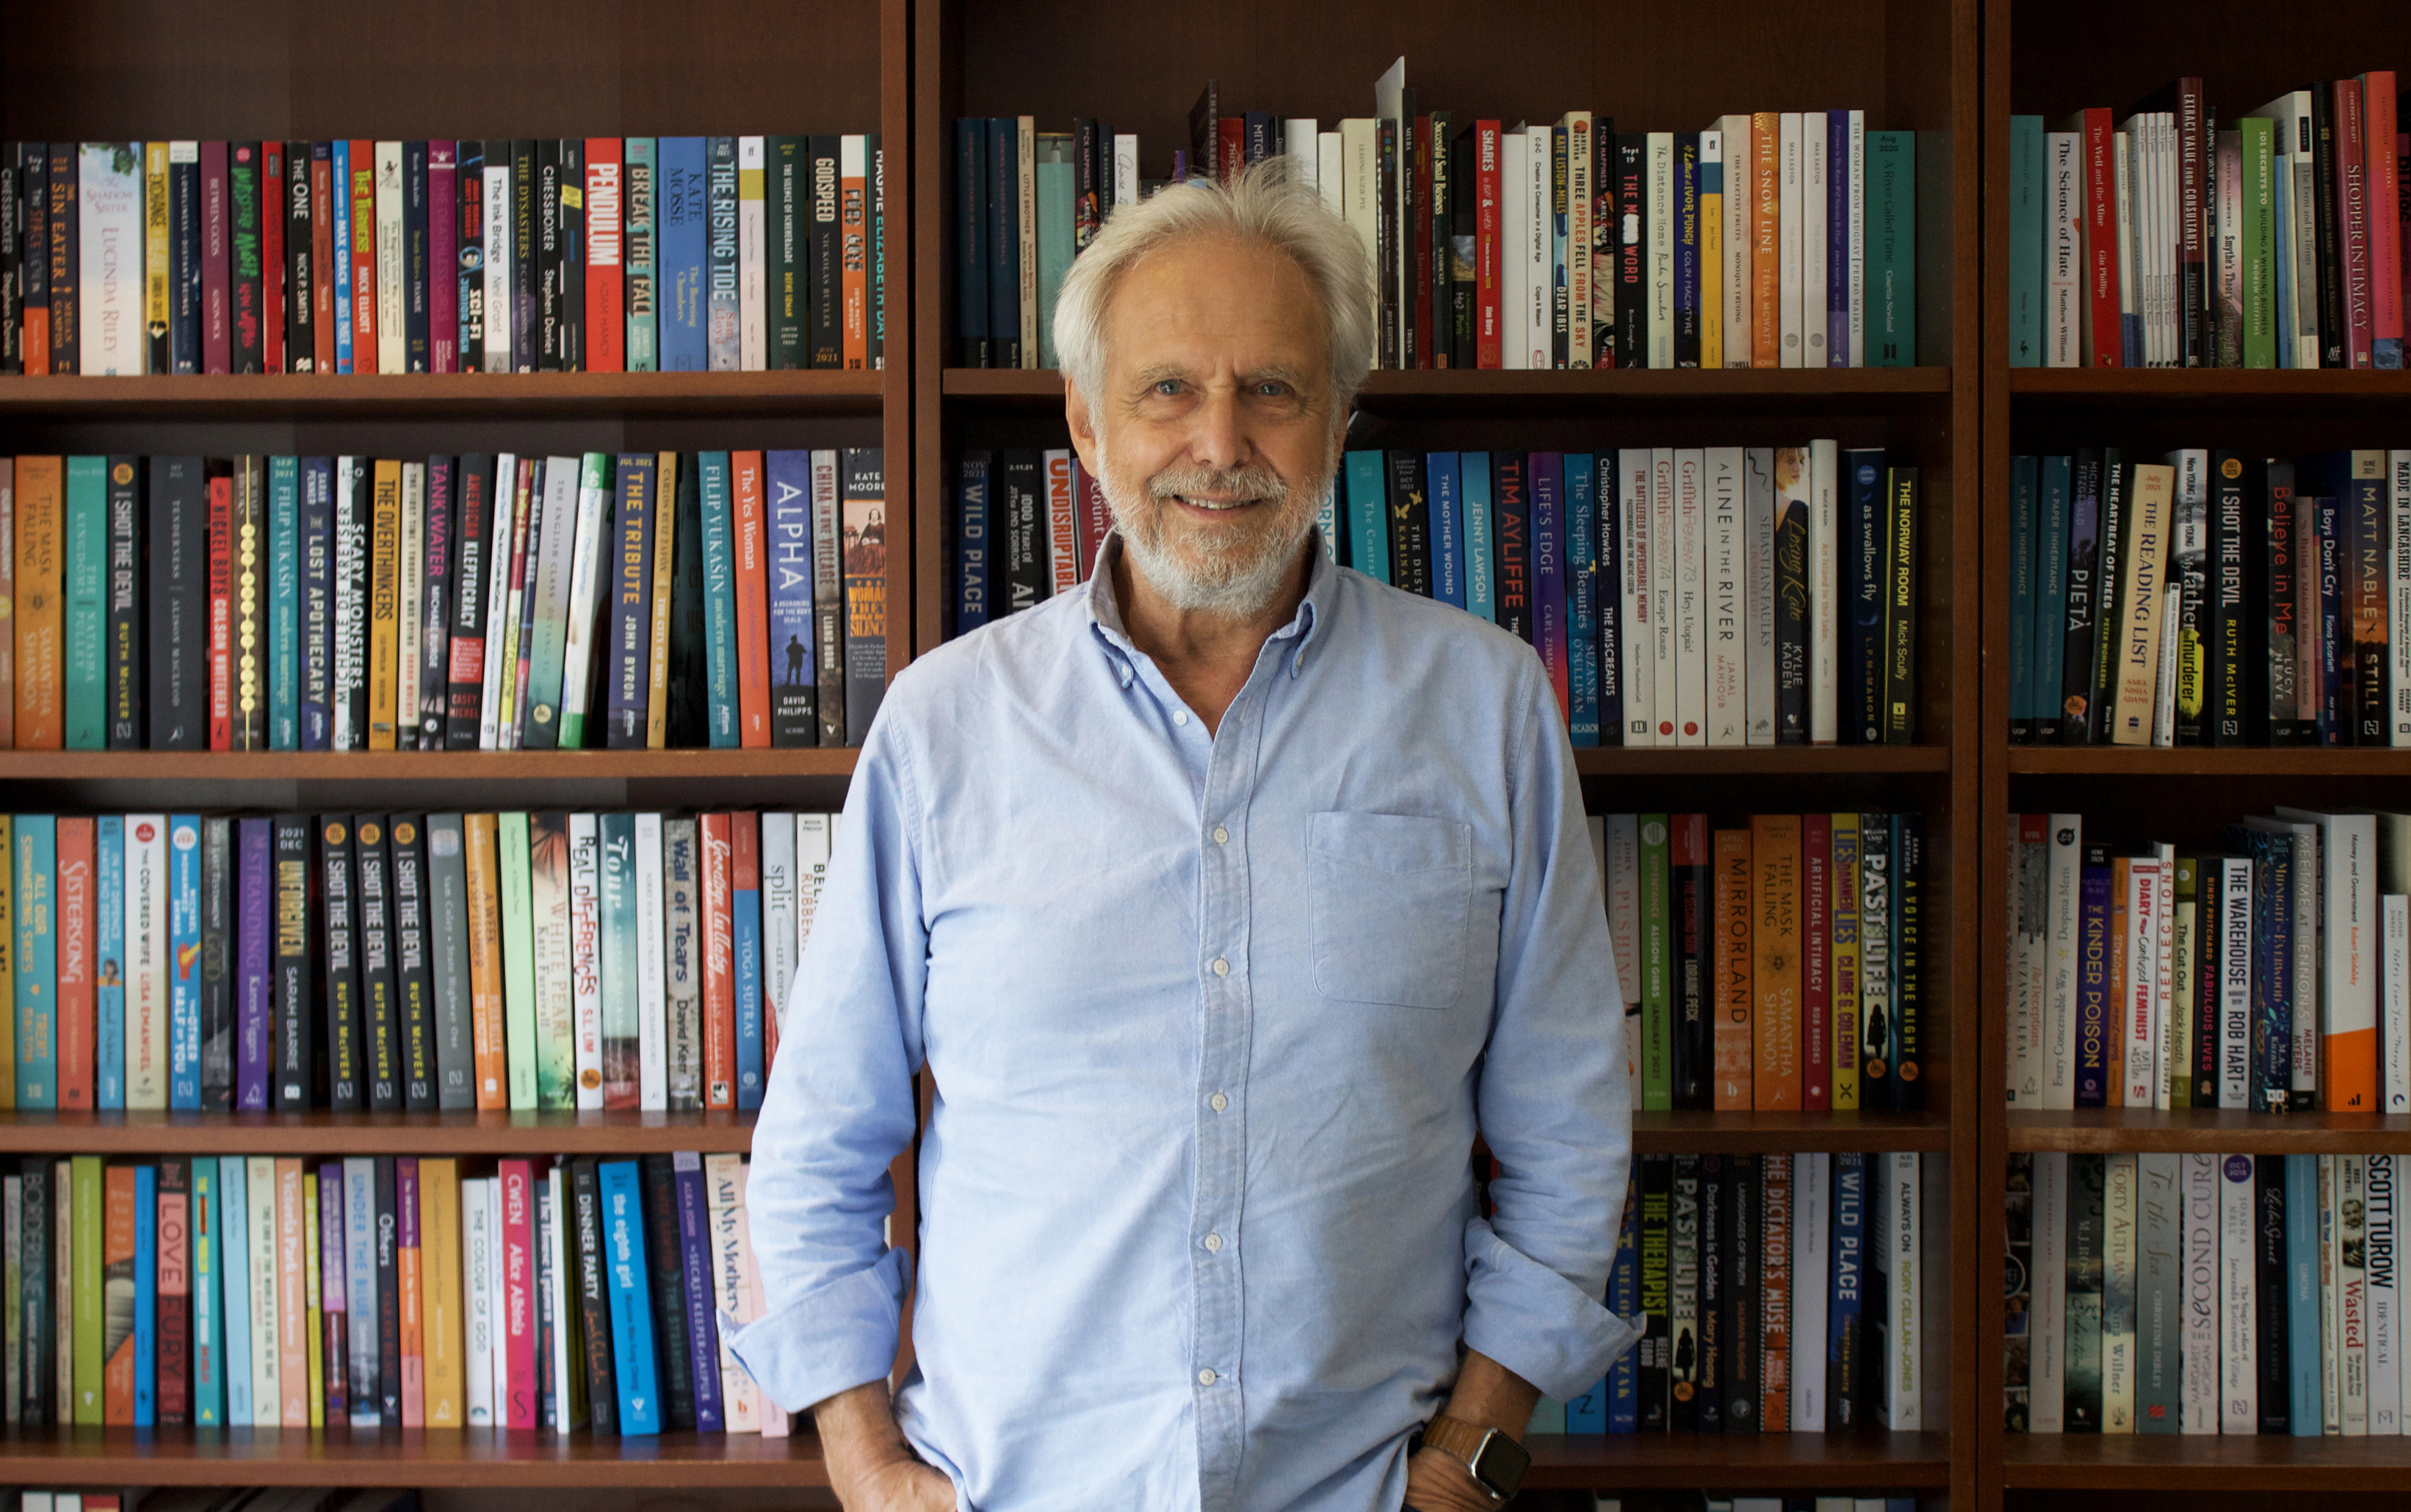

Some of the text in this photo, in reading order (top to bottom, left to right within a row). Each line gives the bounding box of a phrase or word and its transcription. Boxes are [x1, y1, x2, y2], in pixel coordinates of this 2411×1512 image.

[816, 158, 834, 222] GODSPEED
[1481, 130, 1494, 171] SHARES
[2183, 94, 2197, 250] EXTRACT VALUE CONSULTANTS
[52, 184, 66, 279] SIN EATER
[491, 178, 503, 264] The Ink Bridge
[543, 165, 554, 250] CHESSBOXER
[588, 163, 619, 266] PENDULUM
[632, 167, 651, 319] BREAK THE FALL
[712, 161, 736, 301] THE RISING TIDE
[1624, 175, 1638, 283] THE WORD
[2059, 140, 2071, 278] The Science of Hate
[2348, 165, 2366, 330] SHOPPER INTIMACY
[101, 227, 120, 352] LUCINDA RILEY
[1575, 167, 1586, 347] THREE APPLES FELL FROM THE SKY
[115, 500, 131, 538] SHOT
[430, 464, 447, 577] TANK WATER
[741, 467, 756, 570] The Yes Woman
[855, 472, 880, 480] KATE
[1599, 458, 1611, 566] Christopher Hawkes
[1717, 477, 1732, 524] LINE
[2223, 496, 2240, 533] SHOT
[116, 540, 132, 567] THE
[375, 480, 395, 621] THE OVERTHINKERS
[623, 473, 643, 604] THE TRIBUTE
[777, 481, 804, 590] ALPHA
[965, 484, 983, 614] WILD PLACE
[1442, 500, 1451, 549] MOTHER
[1473, 502, 1486, 602] JENNY LAWSON
[1500, 460, 1524, 607] TIM AYLIFFE
[1539, 478, 1553, 574] LIFE'S EDGE
[1721, 531, 1729, 543] IN
[1721, 549, 1729, 574] THE
[1864, 505, 1877, 601] as swallows fly
[1897, 481, 1912, 606] THE NORWAY ROOM
[2222, 535, 2240, 563] THE
[2363, 487, 2377, 618] MATT NABLE
[115, 571, 132, 612] DEVIL
[349, 524, 364, 689] SCARY MONSTERS
[1445, 553, 1453, 595] WOUND
[1718, 582, 1733, 640] RIVER
[2130, 501, 2157, 668] THE READING LIST
[2222, 567, 2240, 607] DEVIL
[623, 615, 636, 701] JOHN BYRON
[1604, 607, 1615, 696] THE MISCREANTS
[1793, 645, 1802, 685] KYLIE
[1895, 621, 1907, 680] Mick Scully
[2275, 654, 2283, 701] NEAVE
[2284, 658, 2293, 695] LUCY
[2365, 654, 2378, 710] STILL
[280, 828, 303, 837] 2021
[328, 860, 346, 897] SHOT
[59, 860, 87, 983] SISTERSONG
[330, 900, 347, 927] THE
[673, 839, 690, 983] Wall of Tears
[764, 866, 791, 910] split
[1765, 864, 1776, 926] FALLING
[1812, 858, 1821, 991] ARTIFICIAL INTIMACY
[1834, 830, 1857, 944] LIES LIES
[1865, 855, 1887, 996] PAST LIFE
[2139, 879, 2151, 917] DIARY
[2161, 861, 2172, 999] REFLECTIONS
[2230, 866, 2247, 986] THE WAREHOUSE
[330, 930, 349, 972] DEVIL
[1731, 859, 1747, 1024] MIRRORLAND
[677, 1000, 687, 1038] David
[2084, 918, 2103, 1068] KINDER POISON
[2136, 985, 2148, 1041] FEMINIST
[2203, 965, 2213, 1071] FABULOUS LIVES
[2227, 1010, 2245, 1082] ROB HART
[162, 1204, 182, 1284] LOVE
[507, 1175, 523, 1224] CWEN
[579, 1194, 598, 1300] DINNER PARTY
[717, 1178, 740, 1311] All My Mothers
[1839, 1173, 1859, 1300] WILD PLACE
[1901, 1182, 1911, 1252] ALWAYS ON
[2369, 1154, 2393, 1288] SCOTT TUROW
[1643, 1193, 1668, 1317] THE THERAPIST
[1675, 1179, 1697, 1319] PAST LIFE
[2345, 1278, 2363, 1348] Wasted
